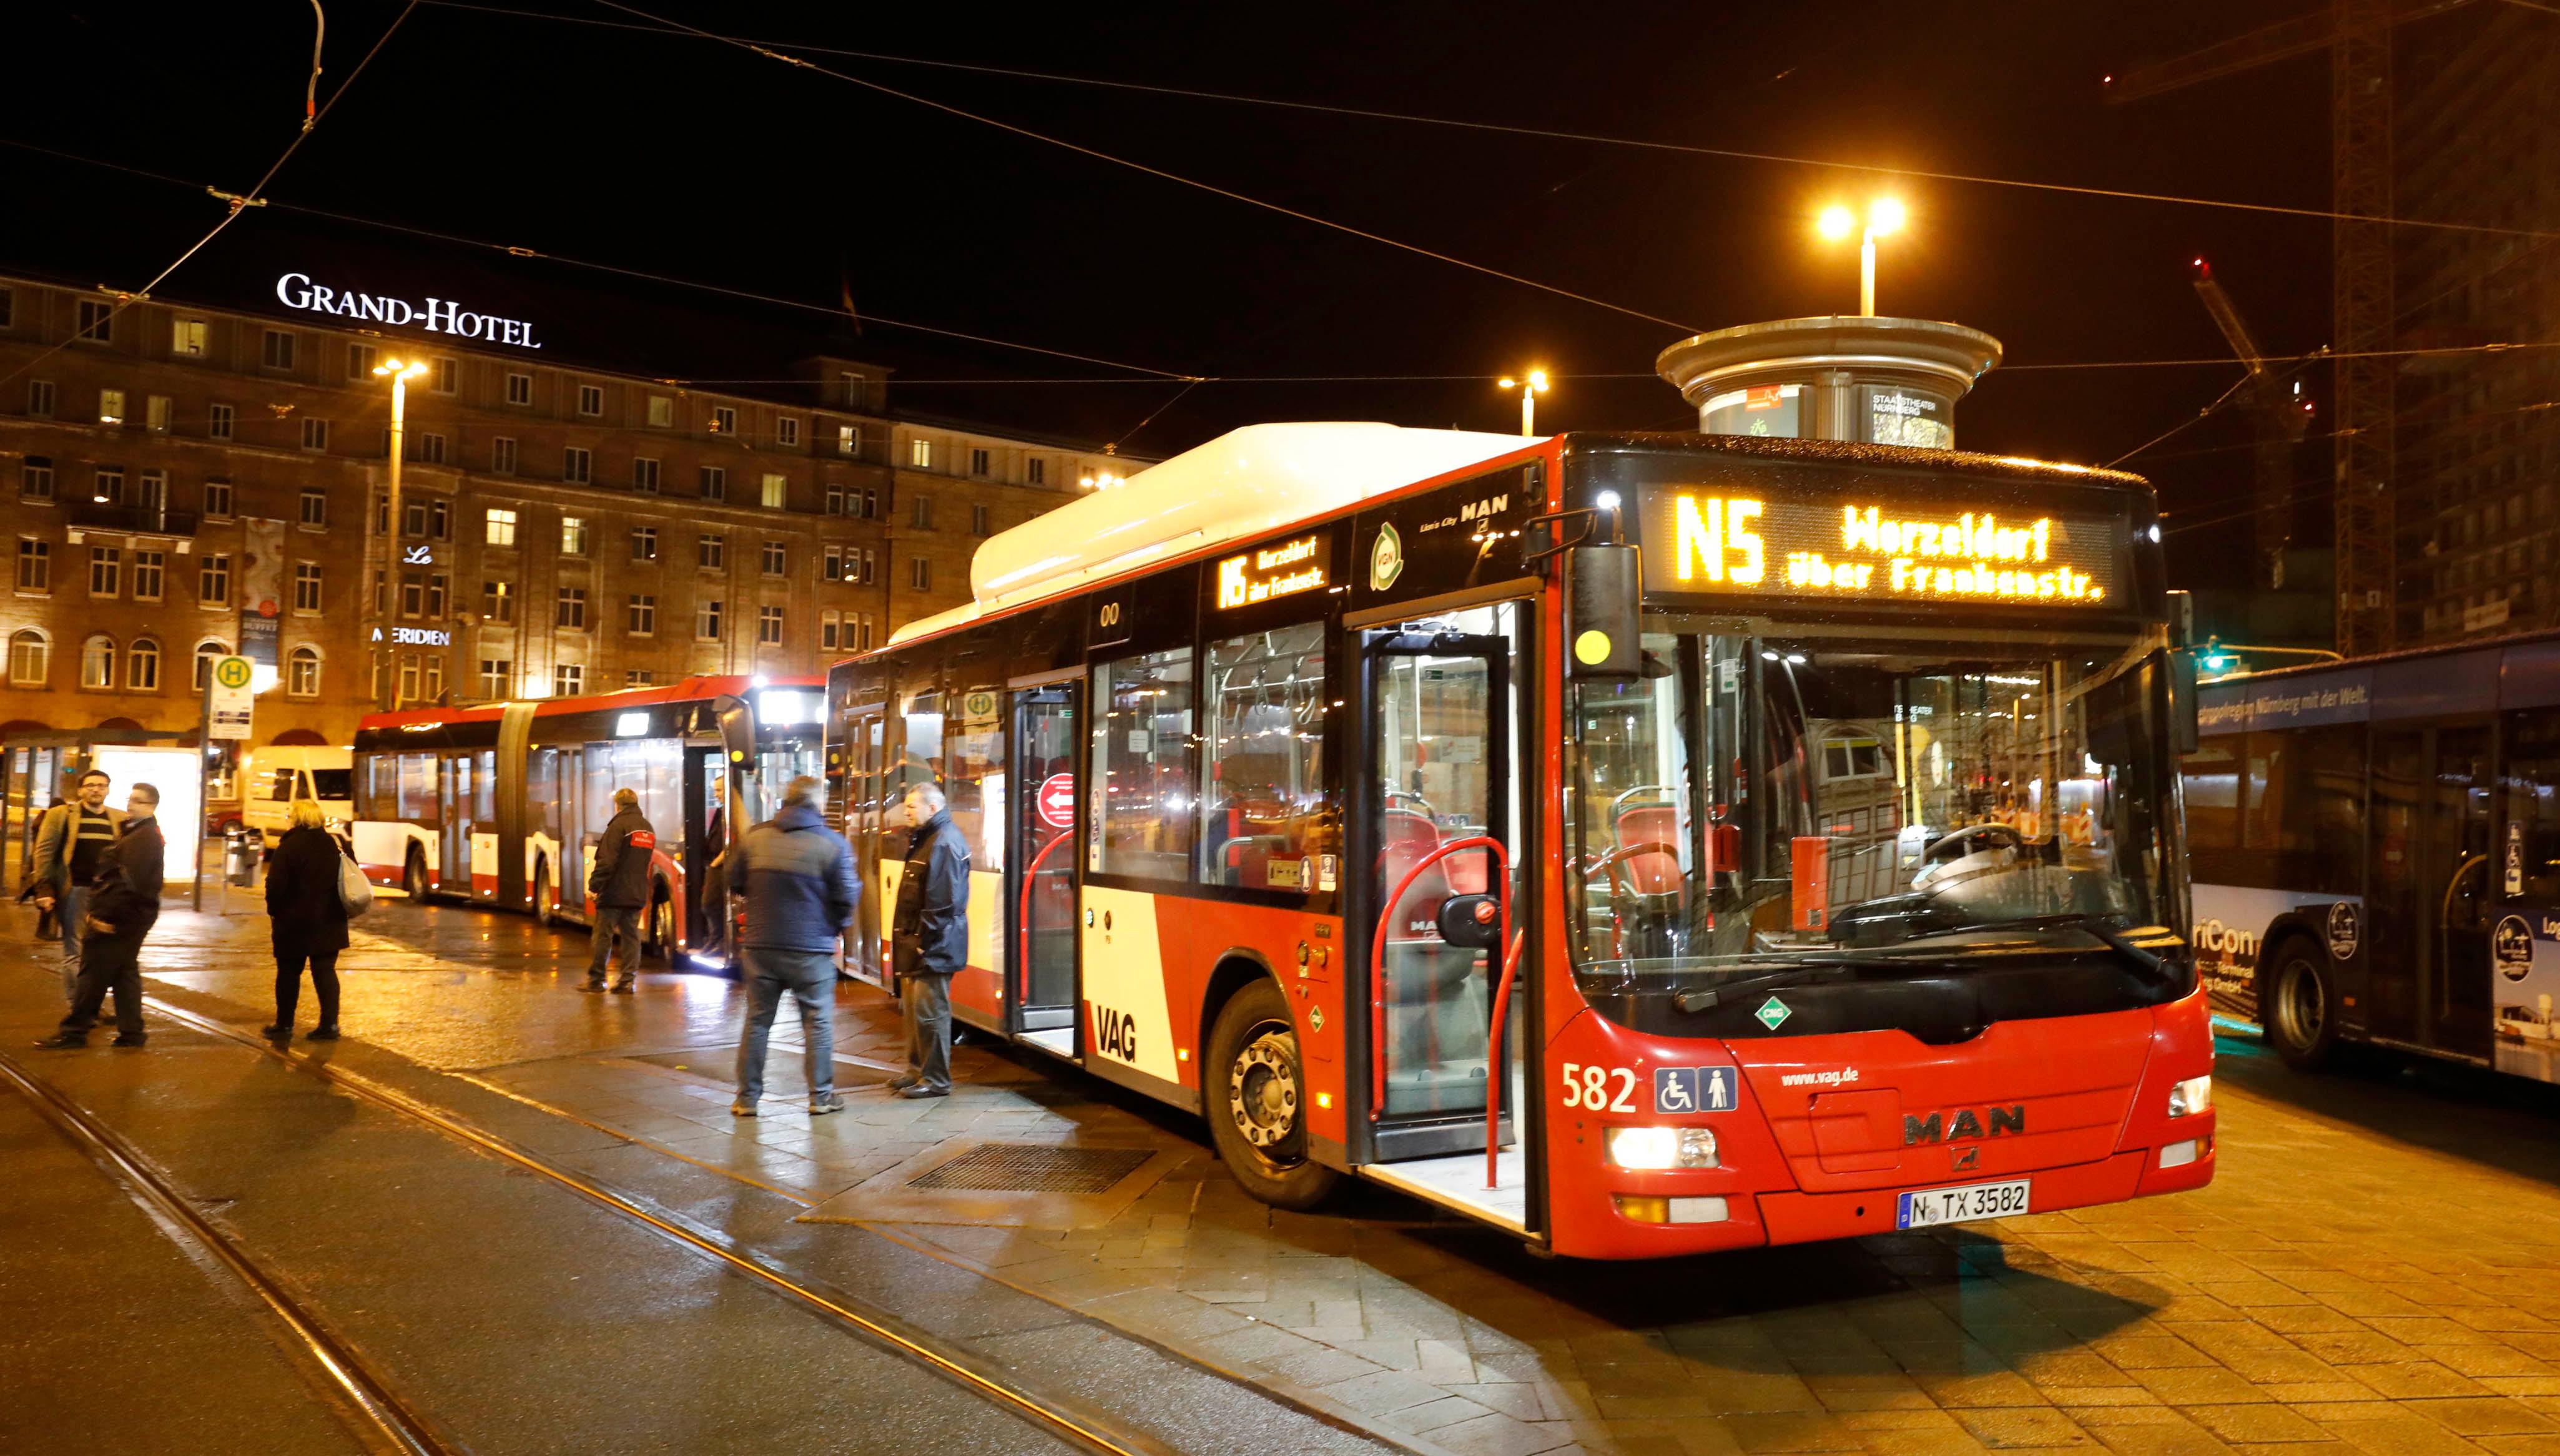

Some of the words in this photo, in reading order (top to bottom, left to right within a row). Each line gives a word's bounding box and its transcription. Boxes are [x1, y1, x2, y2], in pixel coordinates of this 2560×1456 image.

[1460, 494, 1509, 522] MAN
[1676, 495, 1765, 586] N5
[1841, 504, 2050, 561] Worzeldorf
[403, 545, 433, 564] Le
[1785, 552, 1873, 589] über
[1889, 558, 2105, 600] Frankenstr.
[225, 664, 242, 681] H
[2320, 689, 2338, 707] der
[1410, 920, 1438, 931] MA
[2192, 918, 2253, 955] riCon
[1763, 1008, 1784, 1018] CNG
[1097, 1005, 1136, 1063] VAG
[1563, 1063, 1636, 1113] 582
[1781, 1066, 1859, 1086] www.vag.de
[1904, 1105, 2025, 1144] MAN
[1942, 1191, 1969, 1219] TX
[1973, 1186, 2024, 1214] 3582
